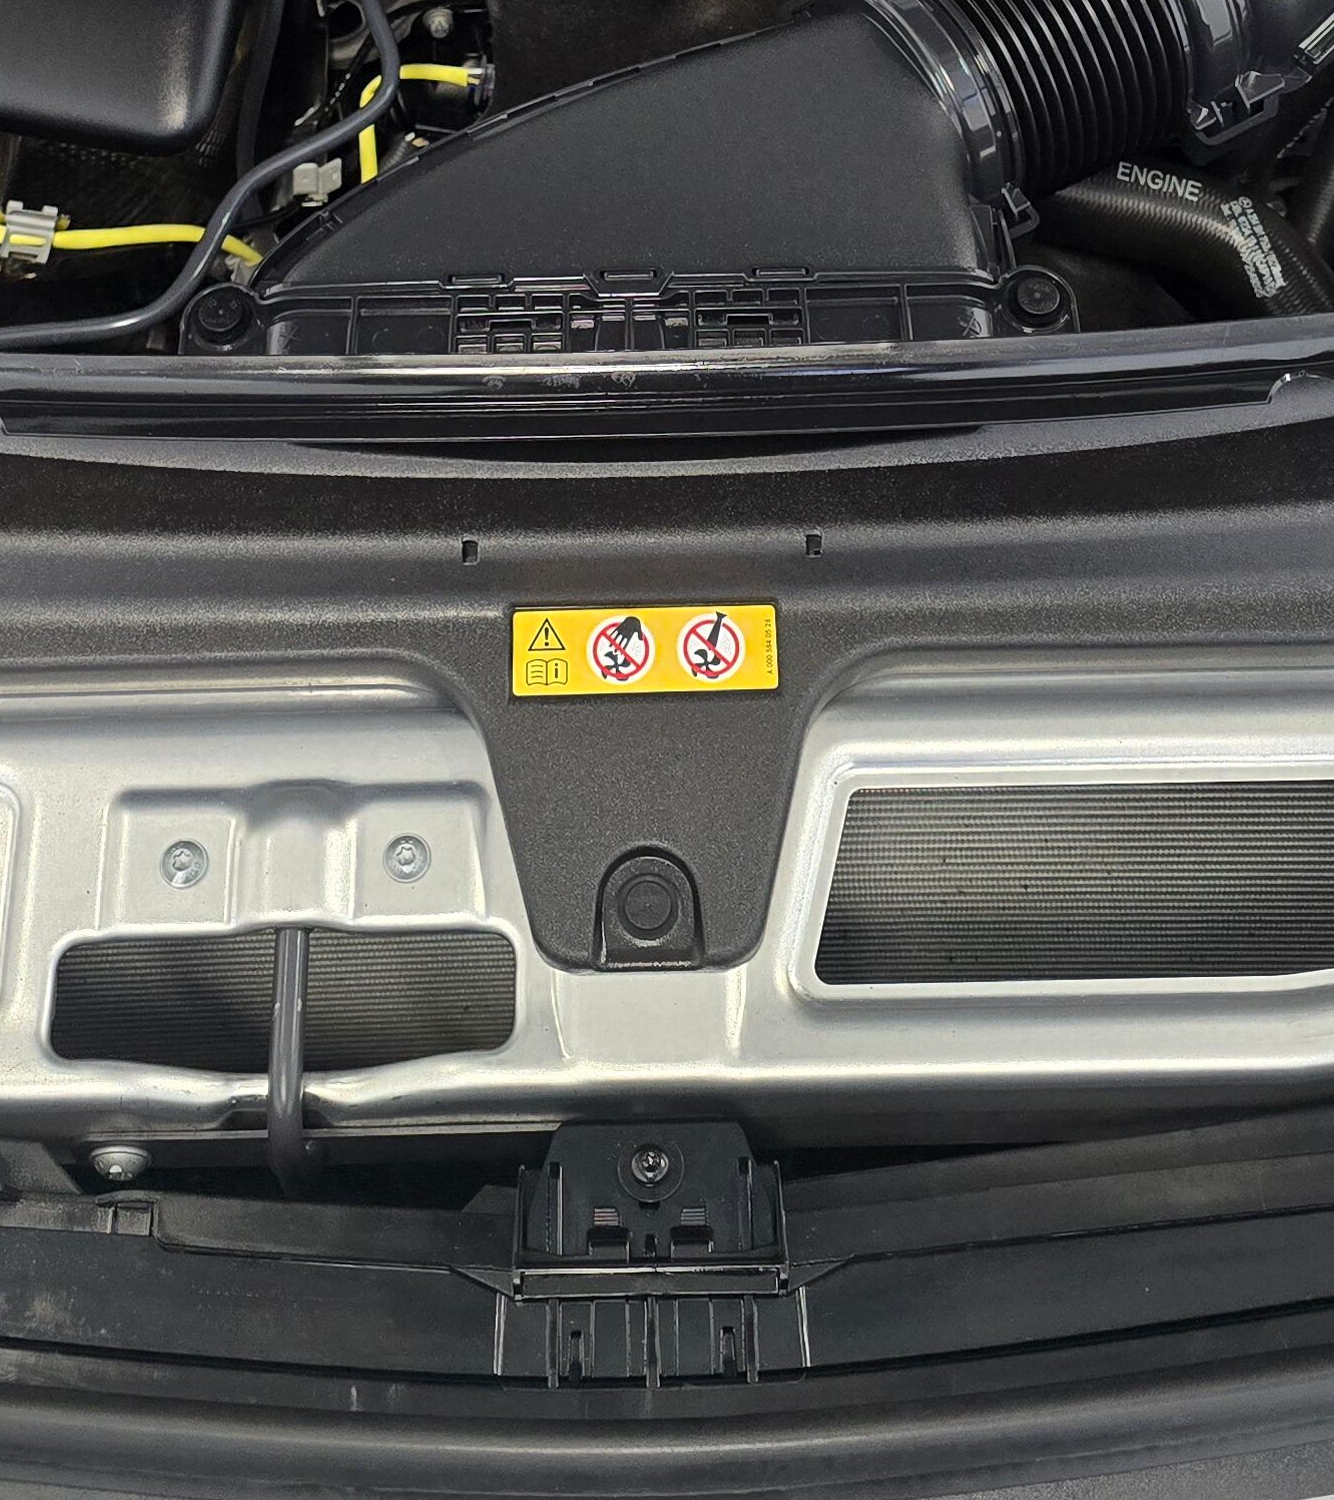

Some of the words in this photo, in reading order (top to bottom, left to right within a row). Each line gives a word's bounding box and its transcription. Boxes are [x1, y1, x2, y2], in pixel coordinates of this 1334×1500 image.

[1116, 161, 1203, 202] ENGINE
[764, 619, 772, 627] 26
[764, 629, 772, 638] 05
[765, 640, 773, 653] 584
